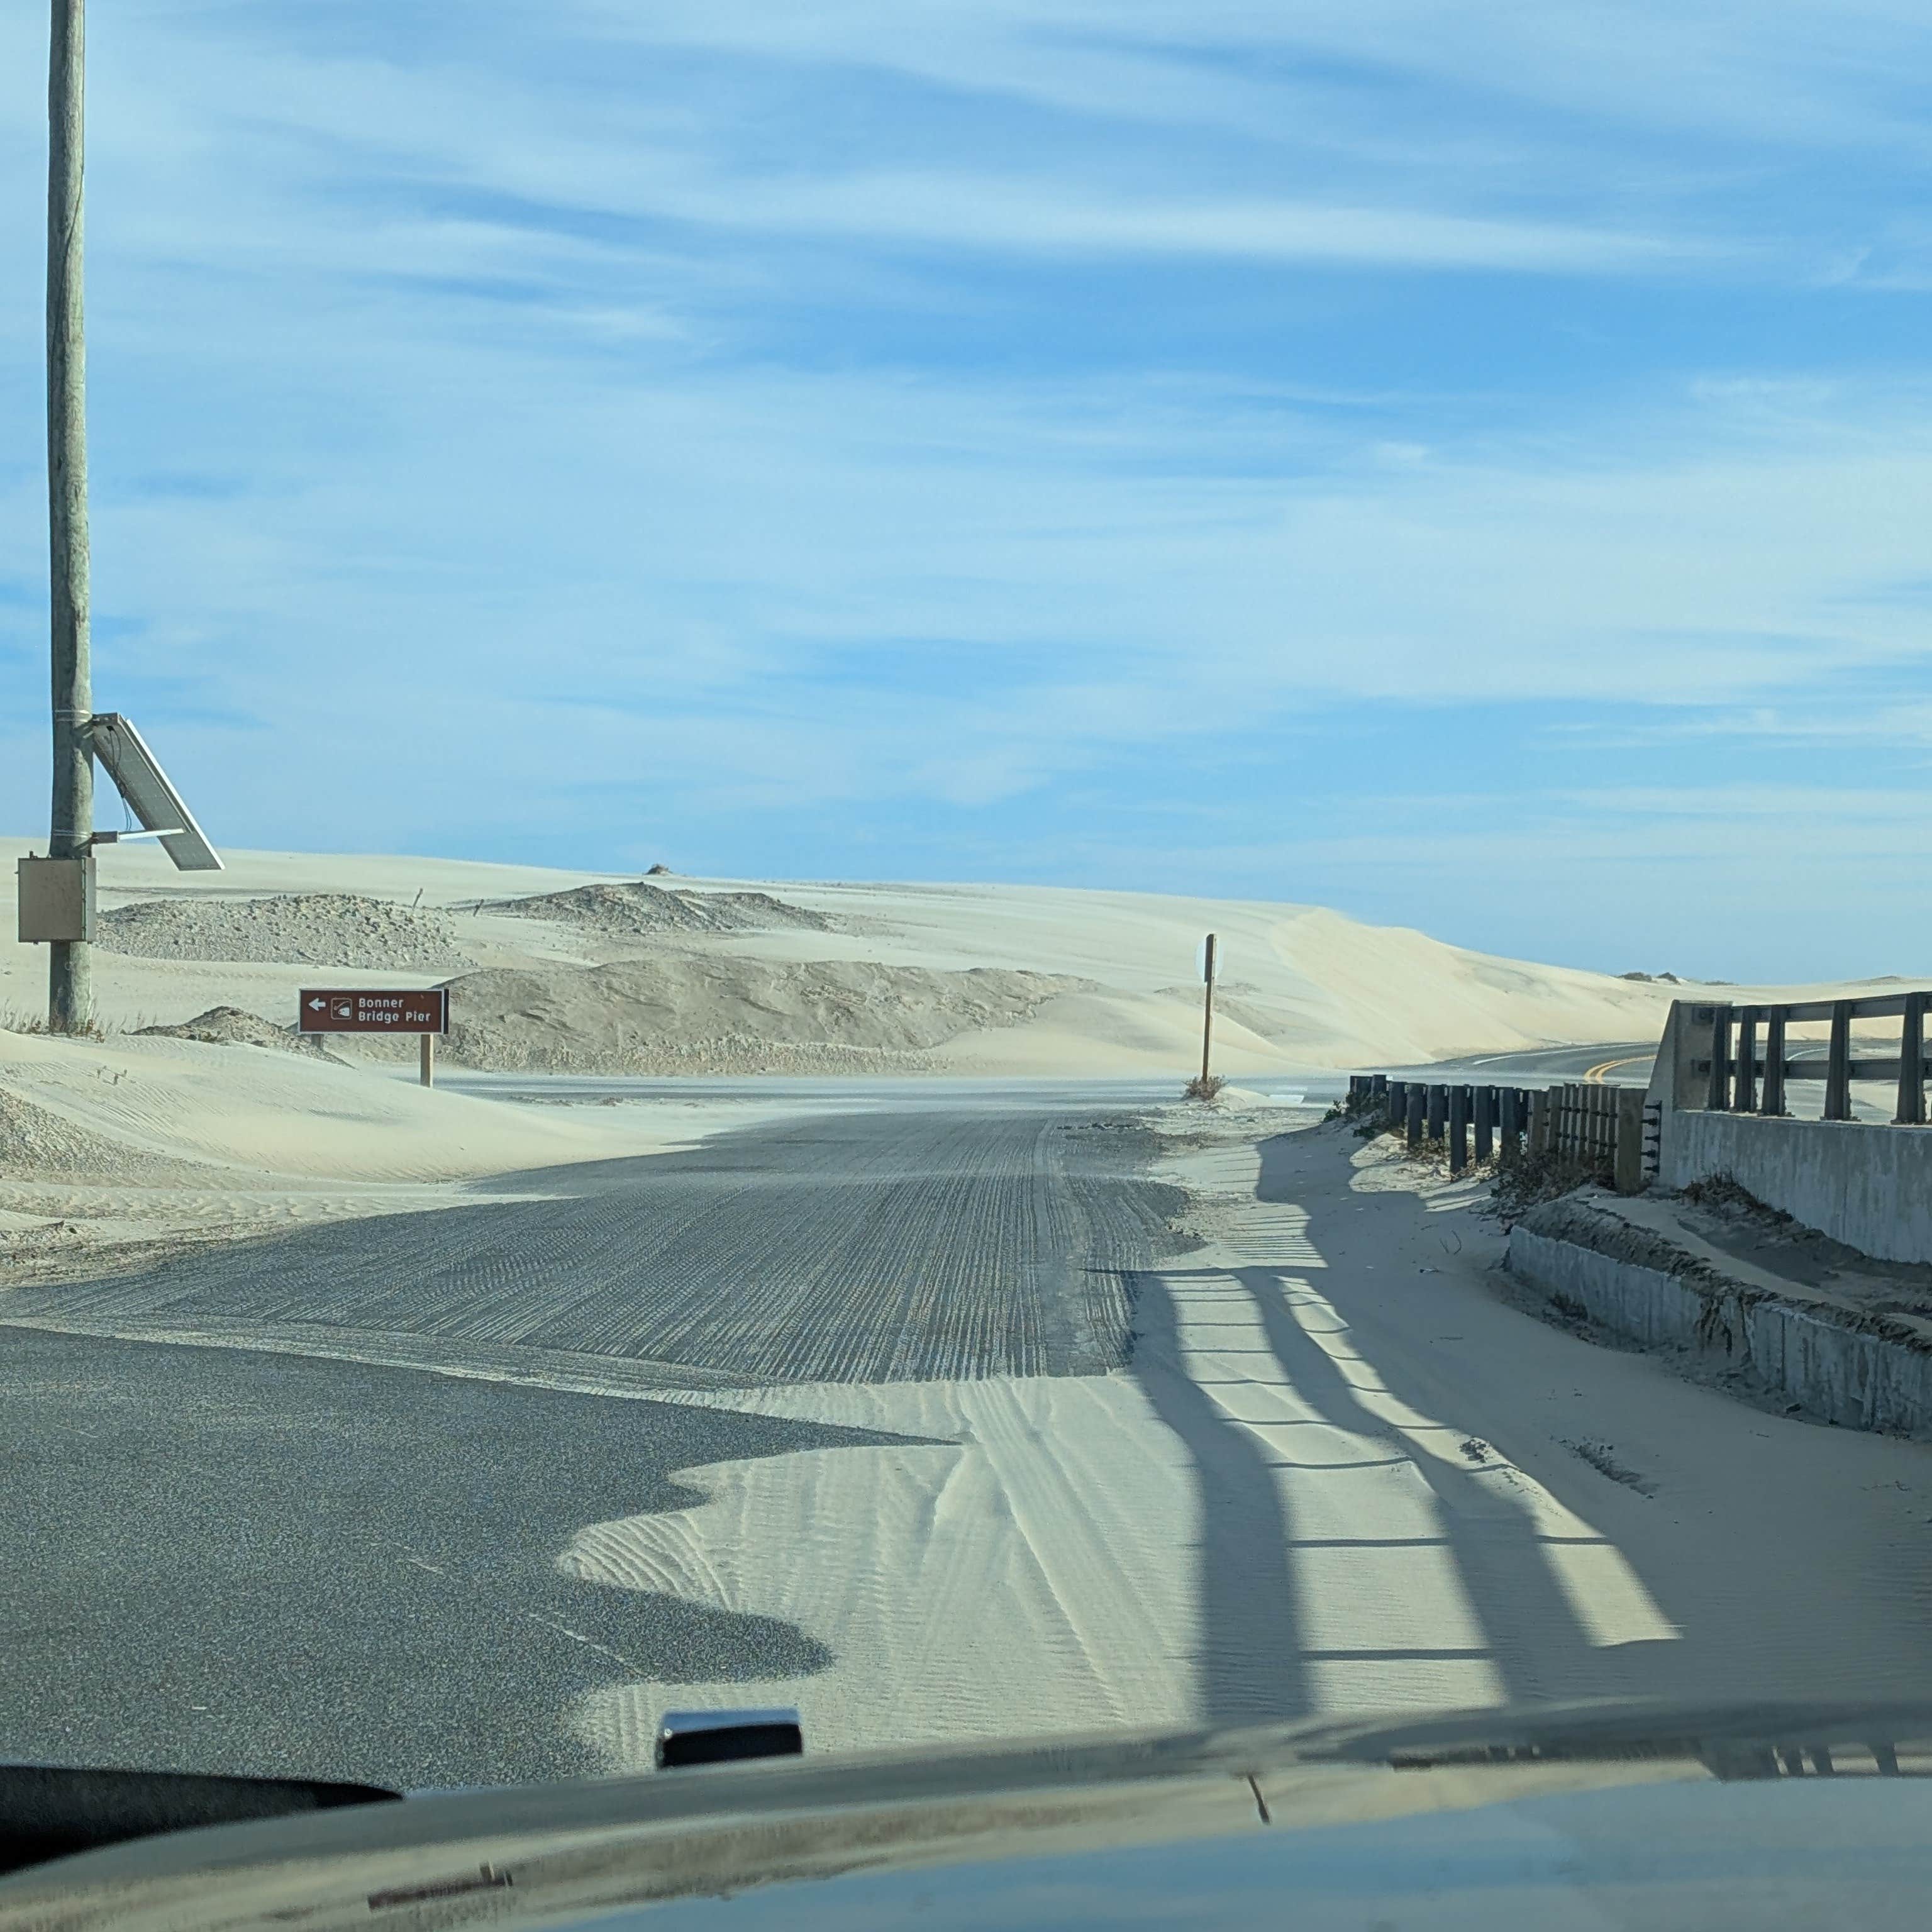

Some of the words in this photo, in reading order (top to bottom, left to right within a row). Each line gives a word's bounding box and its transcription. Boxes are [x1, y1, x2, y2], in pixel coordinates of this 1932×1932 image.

[358, 998, 404, 1008] Bonner
[358, 1011, 399, 1024] Bridge
[406, 1011, 431, 1022] Pier
